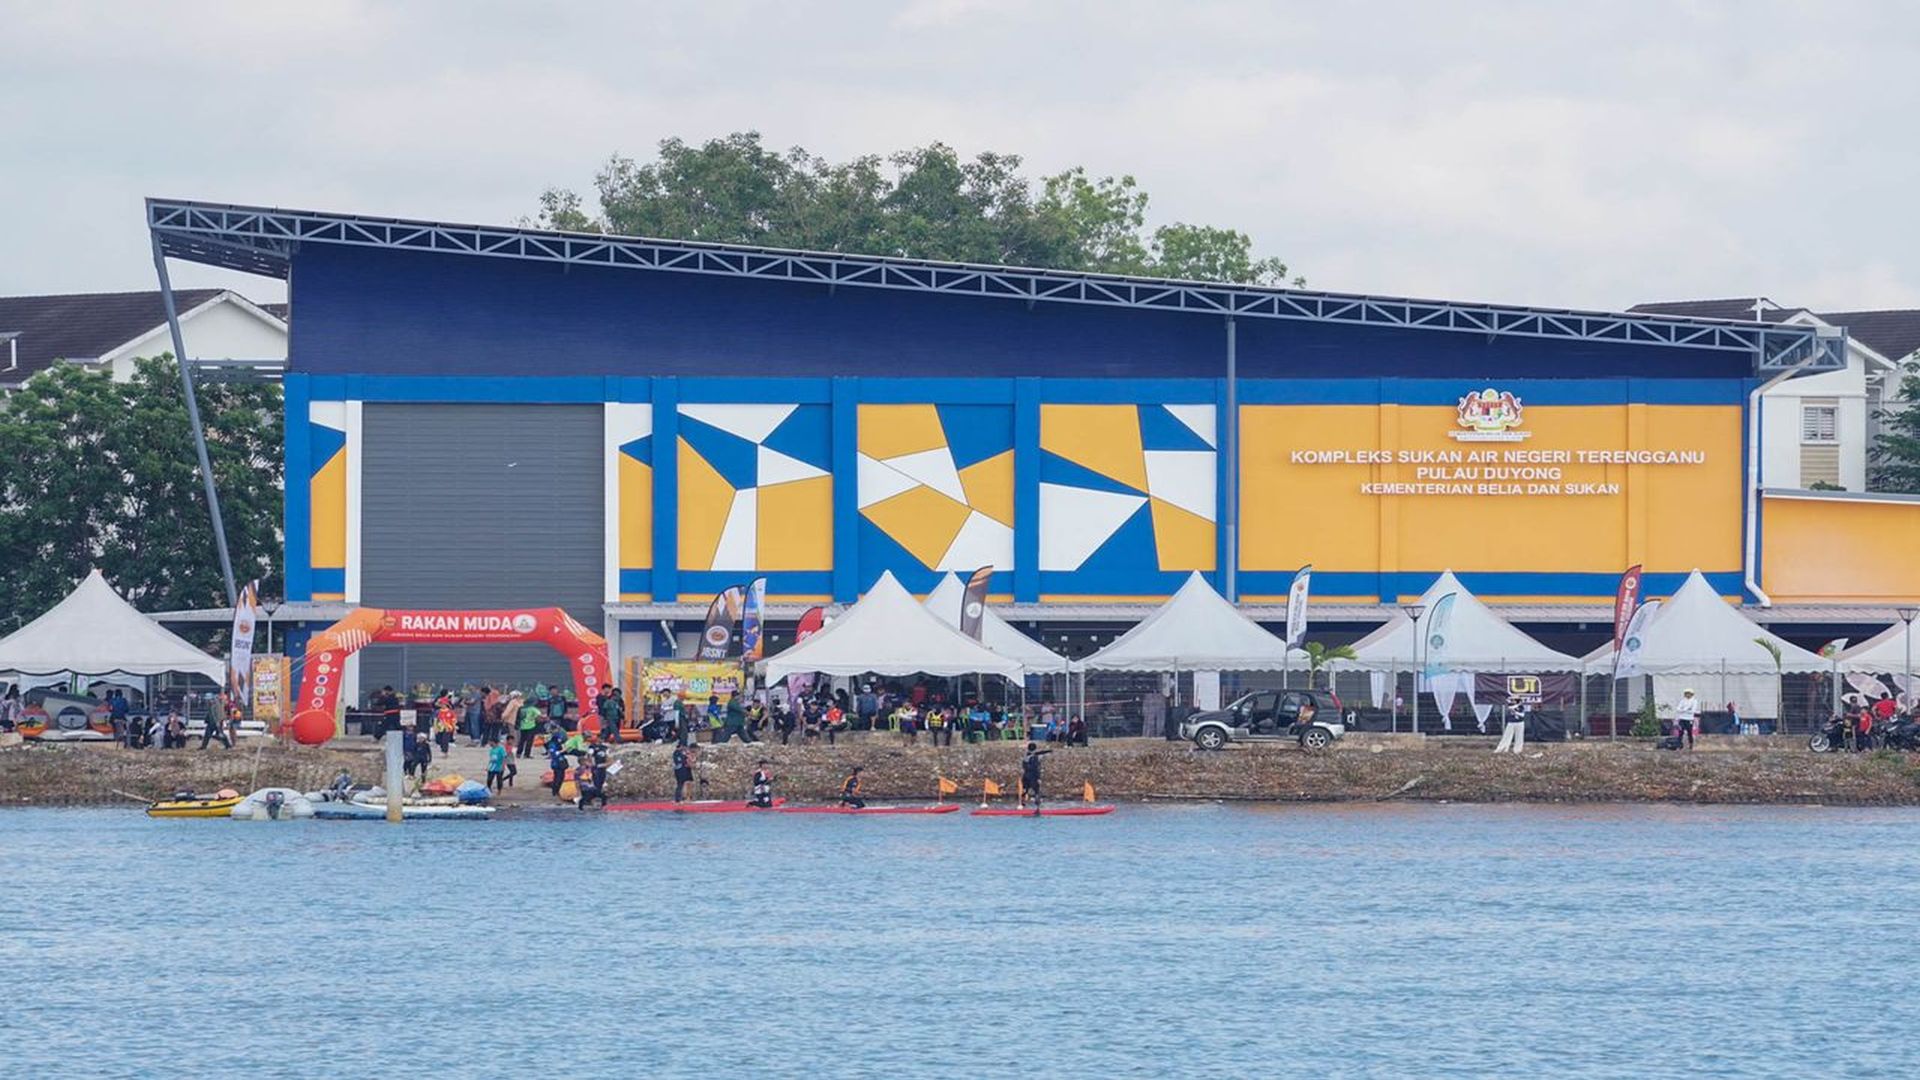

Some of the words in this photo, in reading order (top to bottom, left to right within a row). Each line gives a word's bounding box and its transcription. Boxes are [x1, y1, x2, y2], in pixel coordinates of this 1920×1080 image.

[1291, 450, 1393, 463] KOMPLEKS
[1398, 450, 1463, 463] SUKAN
[1467, 450, 1499, 463] AIR
[1503, 450, 1571, 463] NEGERI
[1576, 450, 1705, 463] TERENGGANU
[1417, 467, 1478, 479] PULAU
[1484, 467, 1562, 479] DUYONG
[1361, 483, 1473, 494] KEMENTERIAN
[1478, 483, 1523, 494] BELIA
[1528, 483, 1560, 494] DAN
[1565, 483, 1620, 494] SUKAN
[402, 615, 459, 630] RAKAN
[464, 616, 512, 630] MUDA
